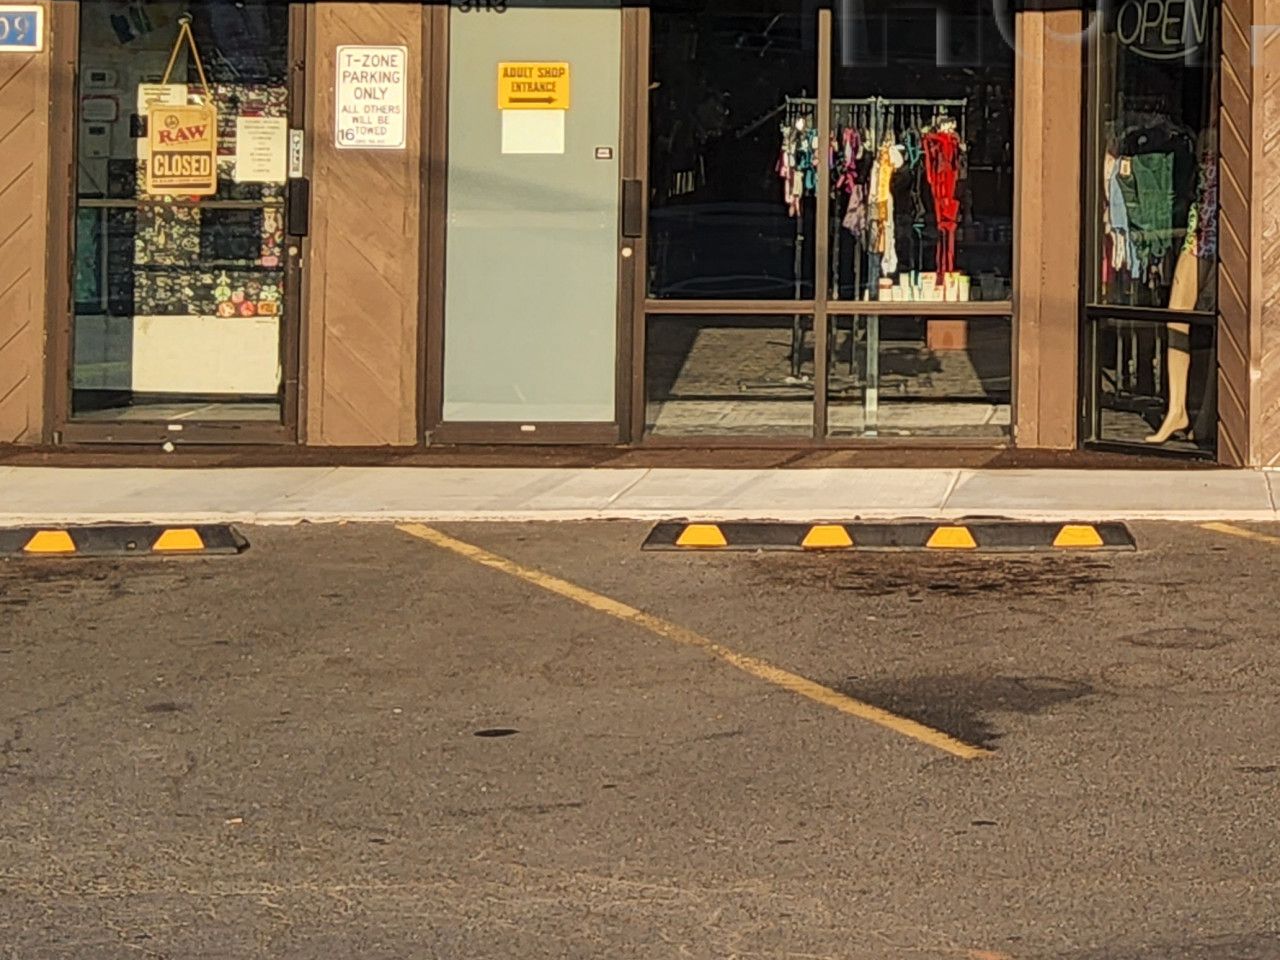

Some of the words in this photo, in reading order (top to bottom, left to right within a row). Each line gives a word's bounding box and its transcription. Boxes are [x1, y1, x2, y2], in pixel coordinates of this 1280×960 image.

[346, 54, 398, 67] T-ZONE
[342, 70, 400, 83] PARKING
[503, 67, 534, 78] ADULT
[537, 67, 566, 78] SHOP
[354, 87, 388, 100] ONLY
[511, 82, 557, 93] ENTRANCE
[341, 105, 358, 113] ALL
[363, 105, 400, 114] OTHERS
[158, 123, 208, 144] RAW
[339, 128, 355, 141] 16
[154, 154, 210, 176] CLOSED
